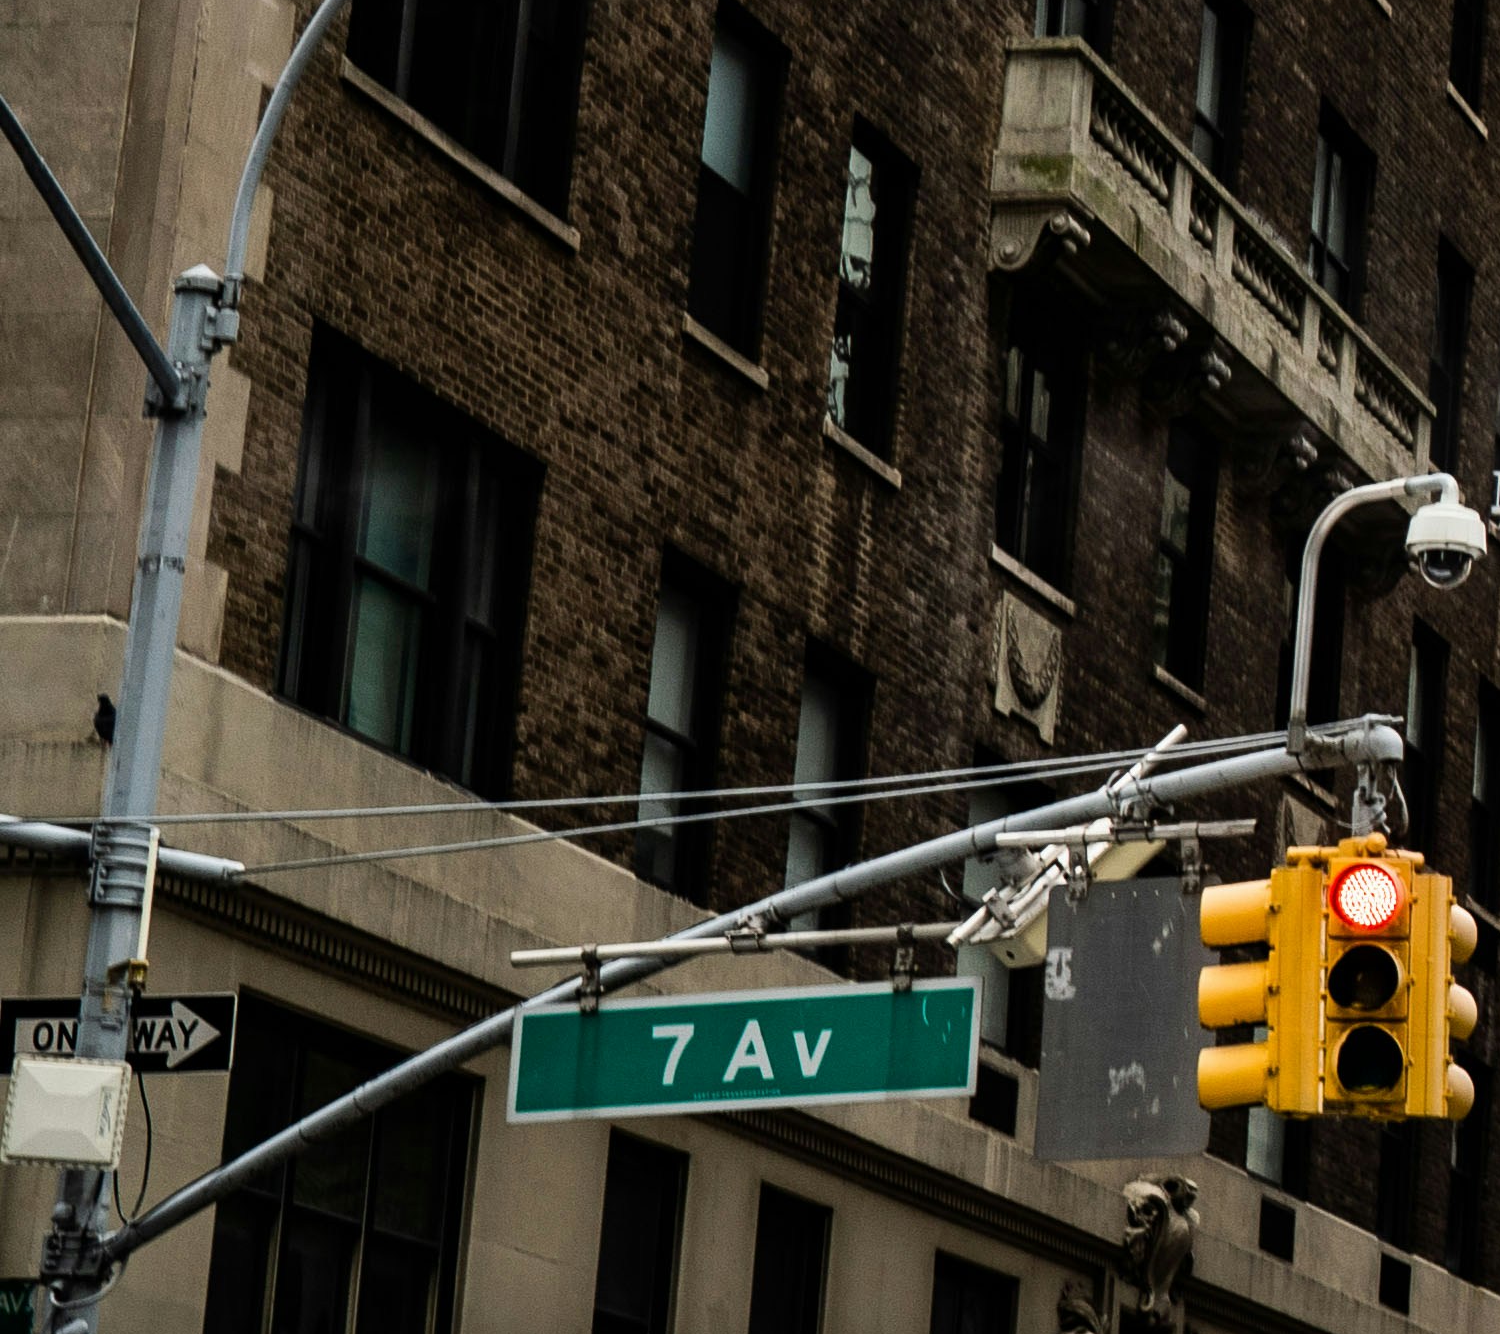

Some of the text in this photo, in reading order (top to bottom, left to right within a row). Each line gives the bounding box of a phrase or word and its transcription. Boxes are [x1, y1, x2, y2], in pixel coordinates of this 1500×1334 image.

[33, 1018, 200, 1051] ON WAY
[652, 1019, 833, 1086] 7 Av
